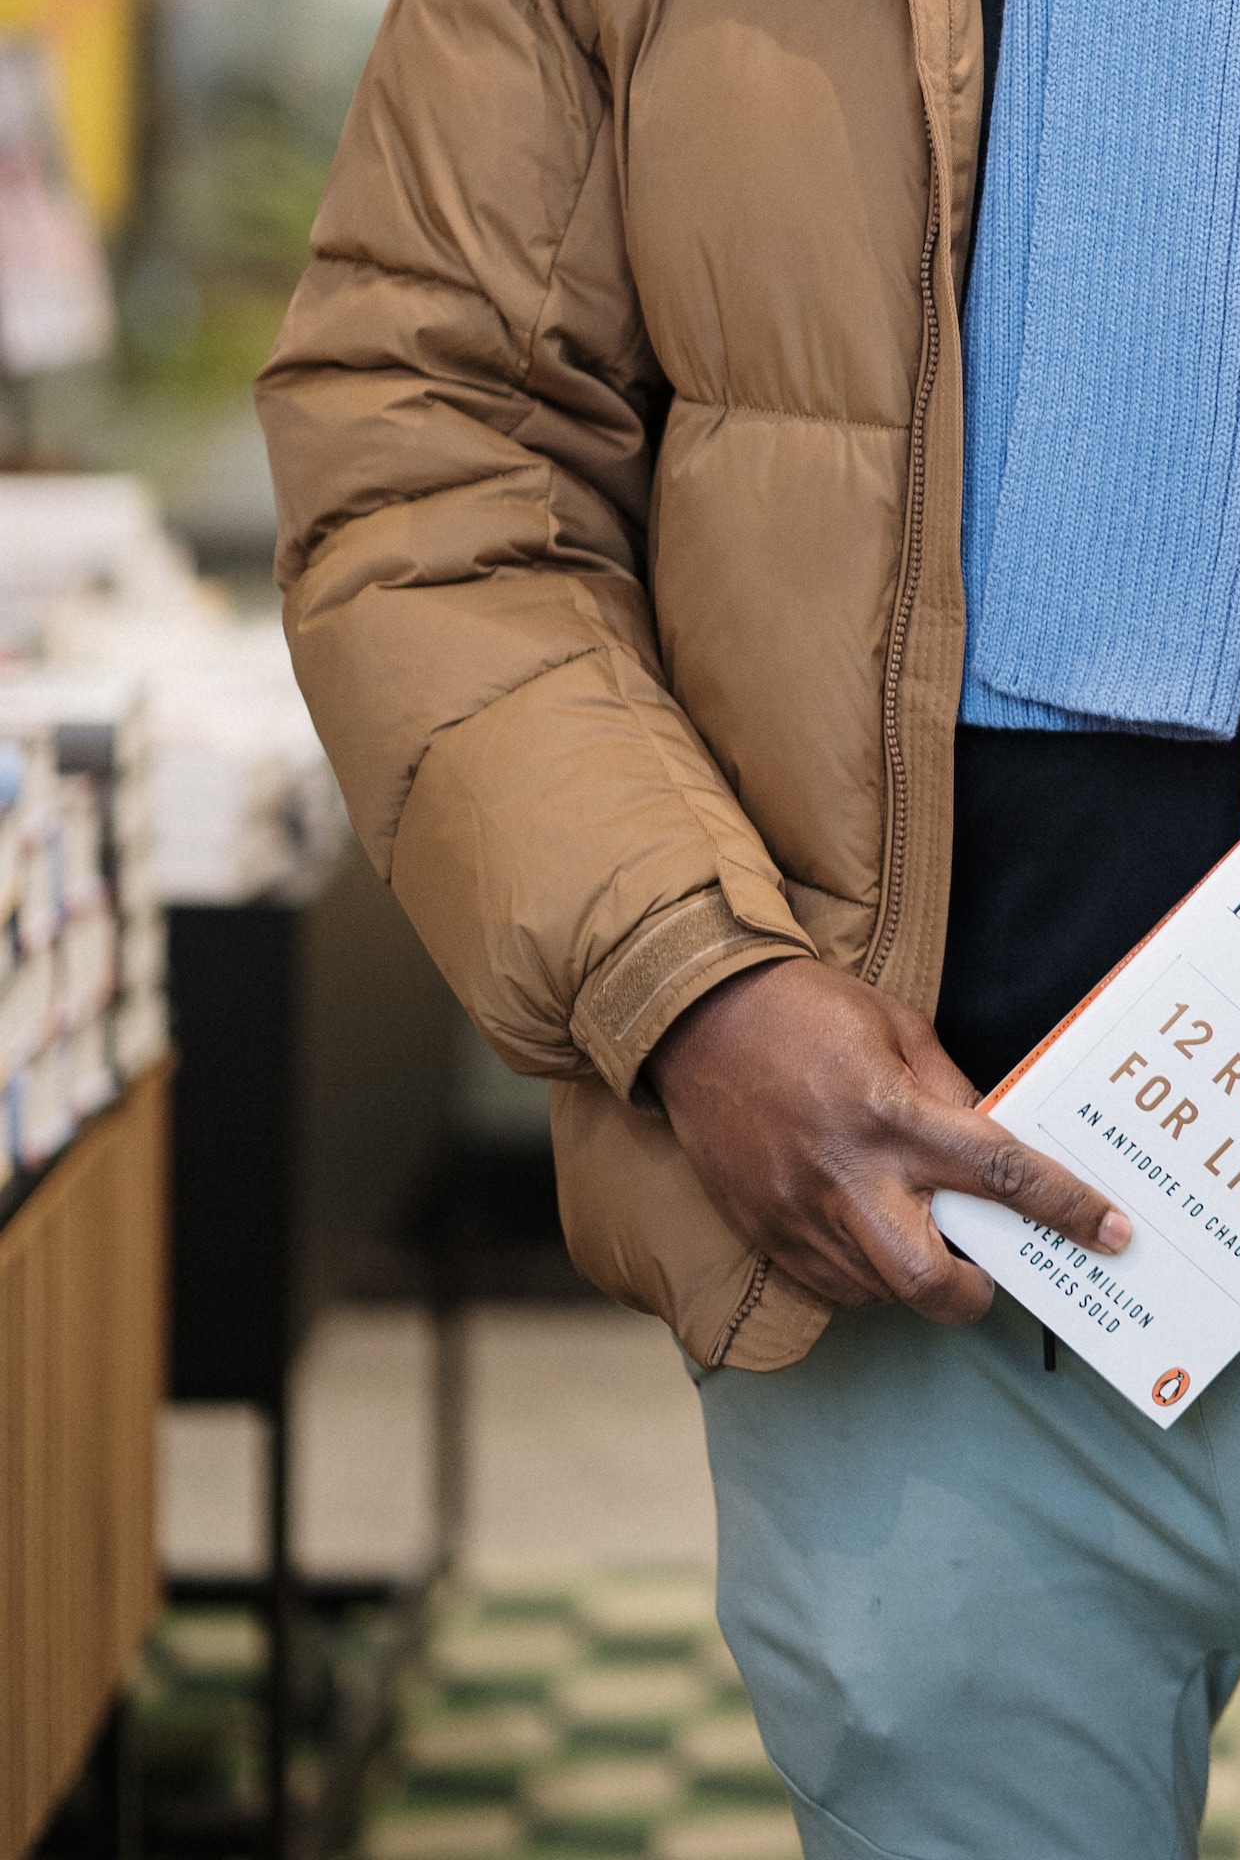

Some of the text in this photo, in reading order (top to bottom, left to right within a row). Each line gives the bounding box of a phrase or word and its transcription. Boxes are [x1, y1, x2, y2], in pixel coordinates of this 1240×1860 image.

[1158, 1001, 1214, 1061] 12
[1108, 1050, 1199, 1141] FOR
[1077, 1103, 1103, 1127] AN
[1102, 1125, 1181, 1197] ANTIDOTE
[1181, 1194, 1204, 1217] TO
[1019, 1242, 1121, 1333] COPIES SOLD
[1066, 1247, 1087, 1268] 10
[1086, 1266, 1155, 1329] MILLION
